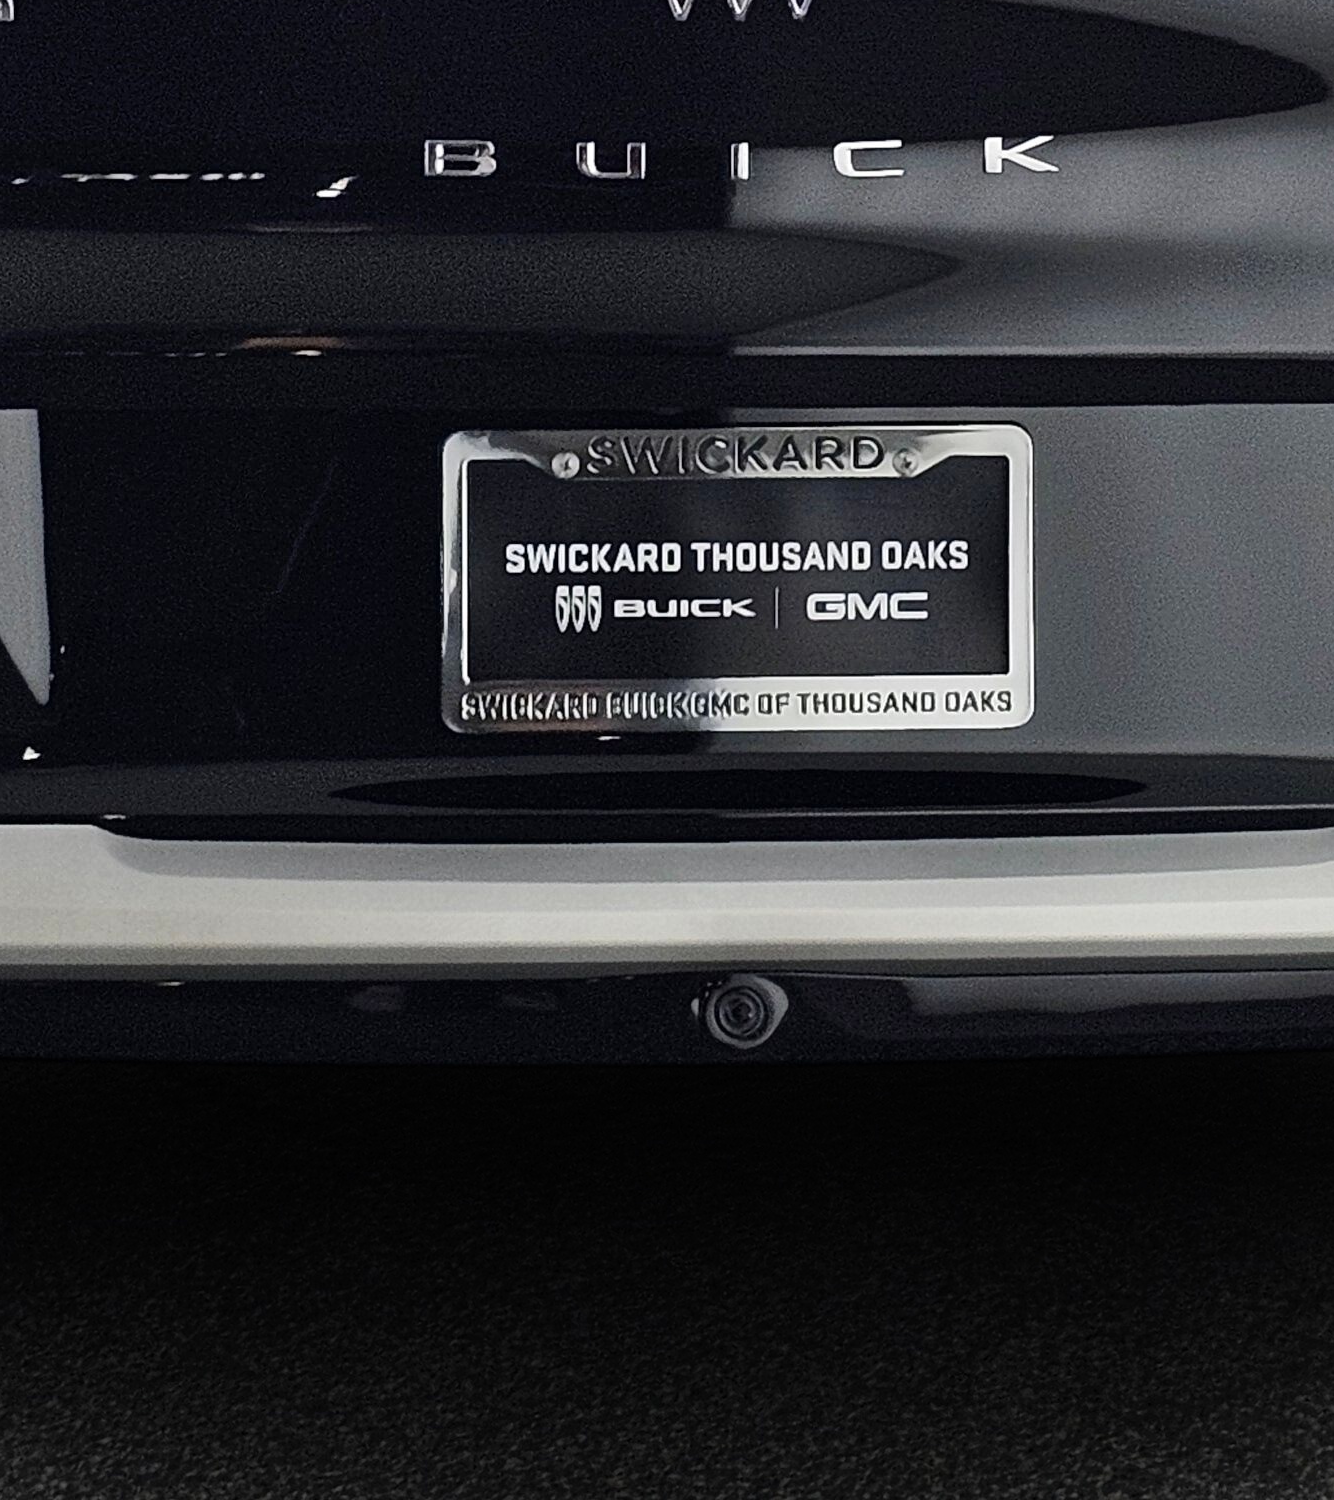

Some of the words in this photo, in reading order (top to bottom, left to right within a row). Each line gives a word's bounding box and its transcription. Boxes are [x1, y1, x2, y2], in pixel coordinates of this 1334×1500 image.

[424, 135, 1059, 180] BUICK
[585, 435, 885, 475] SWICKARD
[505, 542, 681, 573] SWICKARD
[690, 541, 870, 571] THOUSAND
[881, 540, 969, 570] OAKS
[614, 599, 757, 618] BUICK
[806, 592, 928, 620] GMC
[461, 693, 598, 721] SWICKARD
[757, 692, 790, 715] OF
[796, 691, 936, 715] THOUSAND
[944, 690, 1012, 714] OAKS
